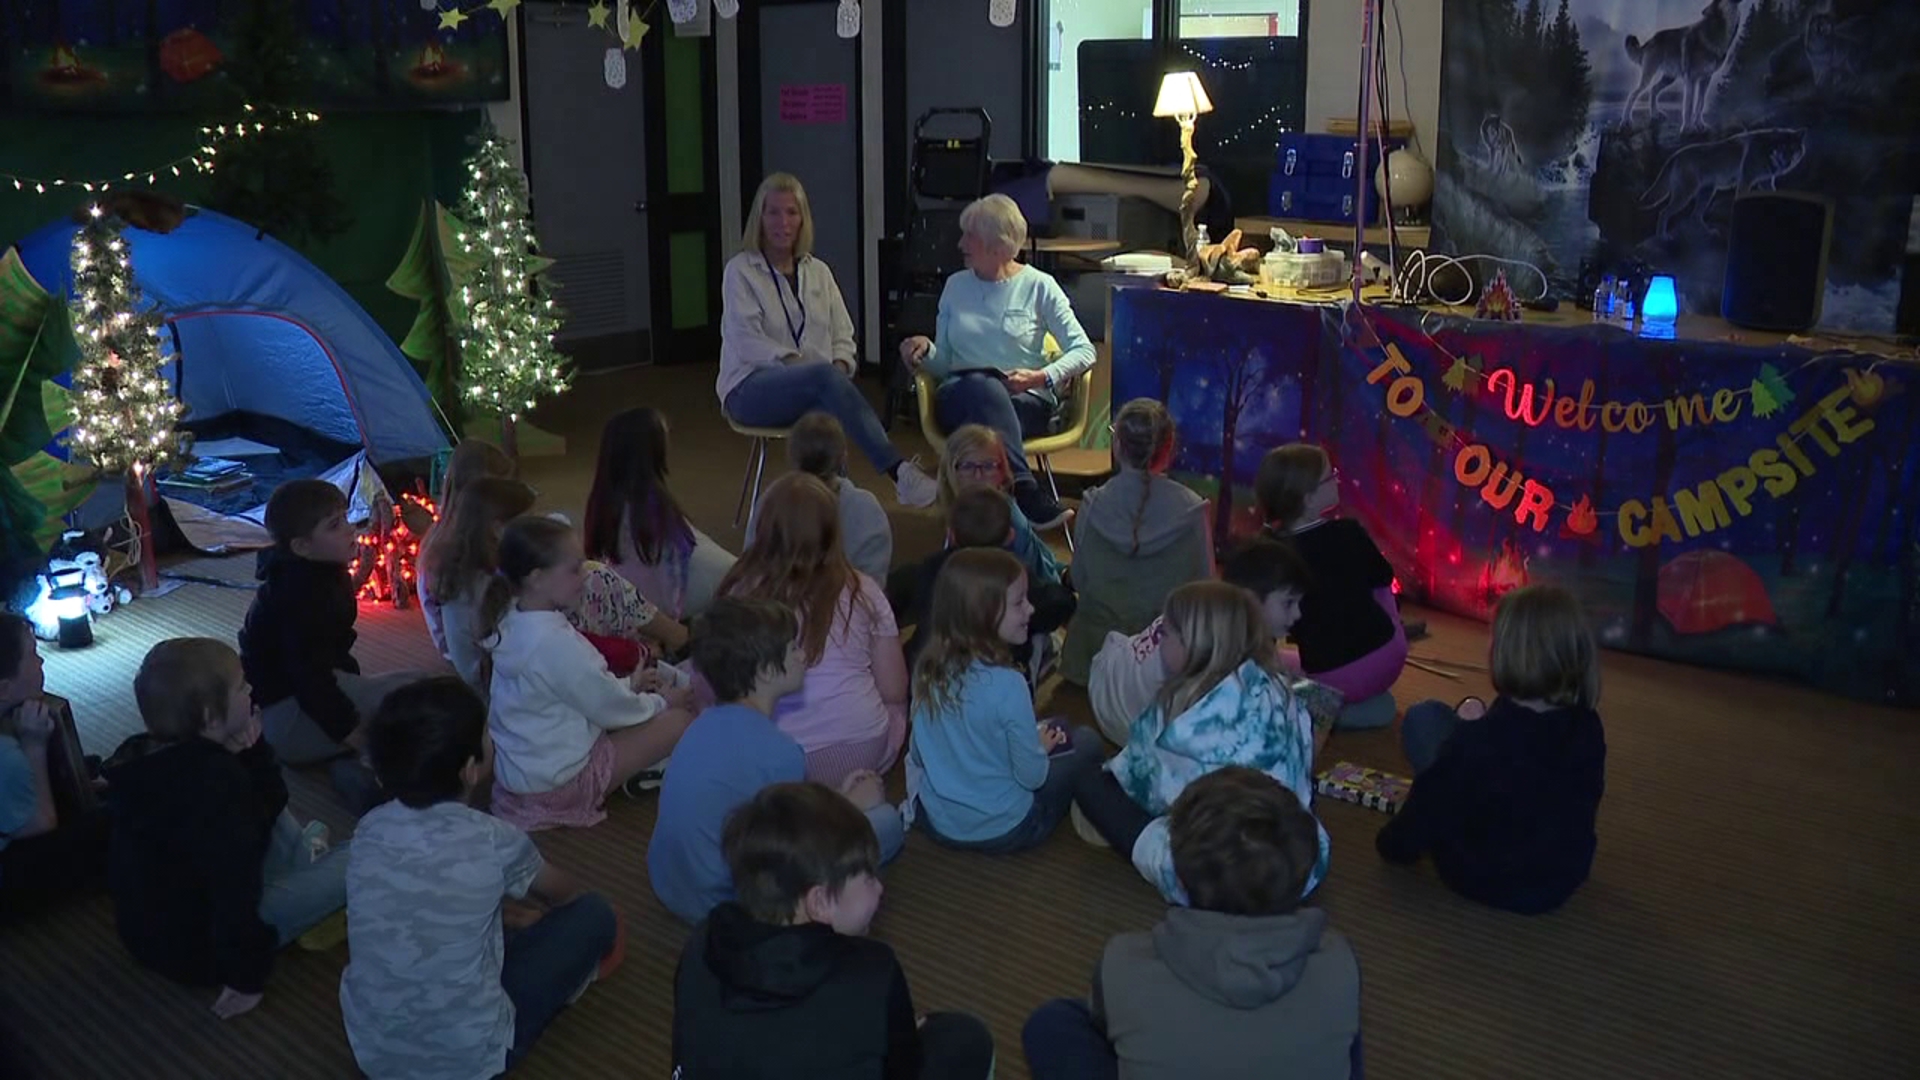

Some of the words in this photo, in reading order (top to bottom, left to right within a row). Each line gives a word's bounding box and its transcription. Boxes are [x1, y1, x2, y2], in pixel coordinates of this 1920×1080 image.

[1366, 342, 1424, 417] TO
[1455, 445, 1554, 532] OUR
[1618, 387, 1875, 547] CAMPSITE
[1487, 369, 1742, 433] Welcome
